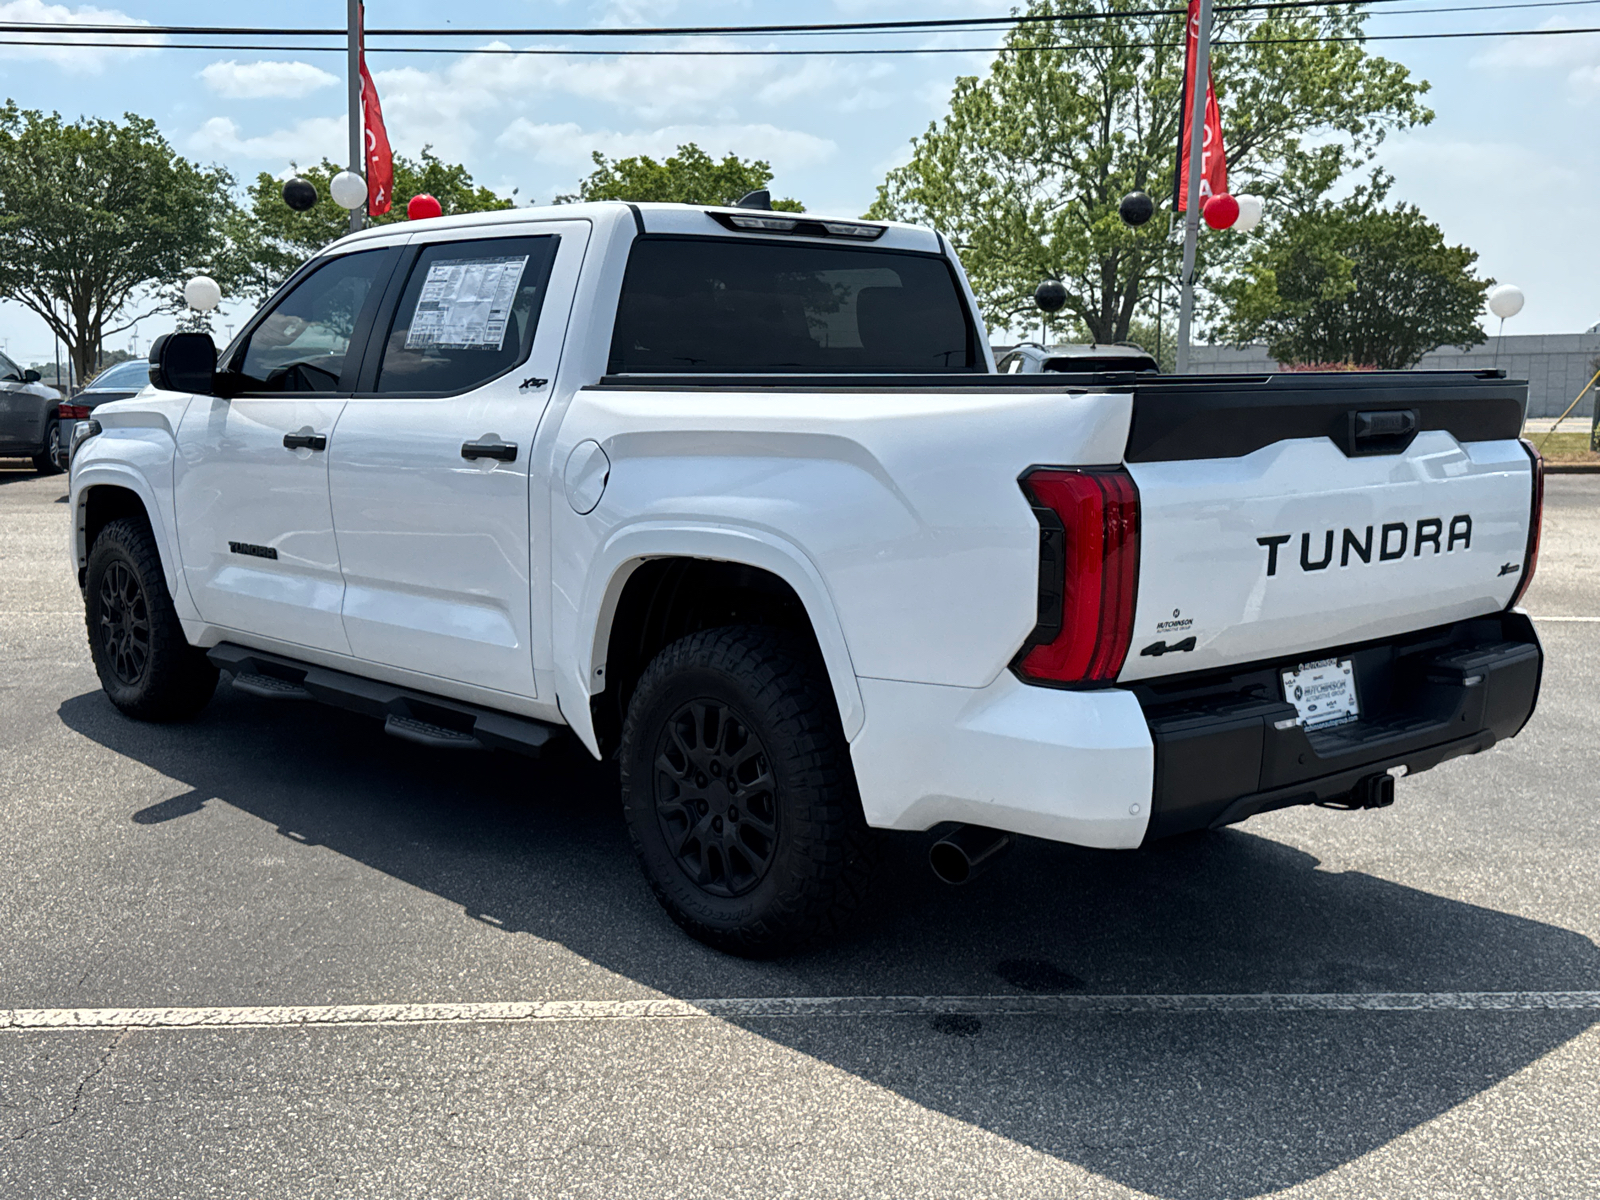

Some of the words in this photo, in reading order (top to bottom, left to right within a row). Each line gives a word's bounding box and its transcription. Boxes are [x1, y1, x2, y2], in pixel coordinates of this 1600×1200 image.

[228, 541, 278, 560] TUNDRA
[1256, 514, 1472, 577] TUNDRA
[1156, 618, 1194, 629] HUTCHINSON
[1304, 679, 1346, 696] HUTCHINSON
